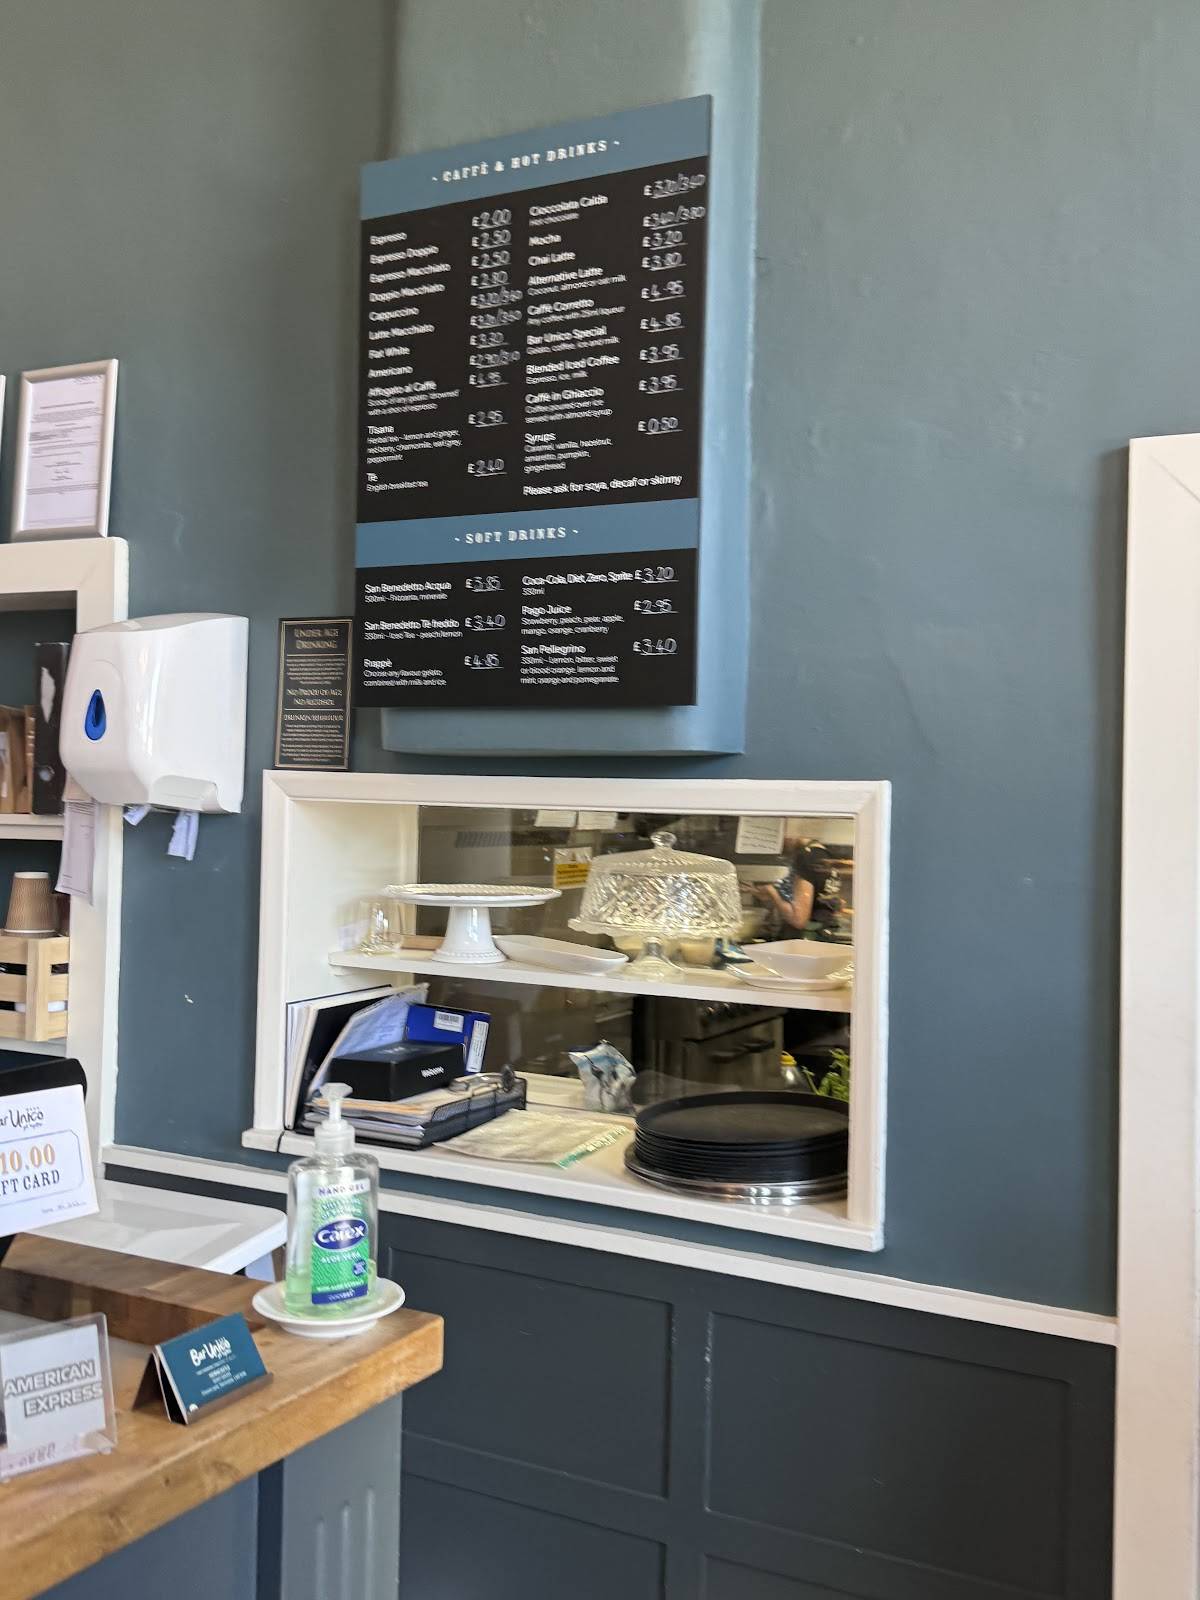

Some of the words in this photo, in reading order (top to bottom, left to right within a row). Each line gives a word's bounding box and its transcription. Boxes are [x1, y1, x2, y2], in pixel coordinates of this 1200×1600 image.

[443, 161, 488, 182] CAFFÈ
[494, 161, 504, 172] &
[511, 153, 540, 169] HOT
[546, 140, 607, 162] DRINKS
[529, 201, 579, 216] Cioccolata
[579, 194, 608, 207] Calda
[370, 232, 407, 245] Espresso
[529, 234, 561, 246] Mocha
[528, 254, 550, 266] Chai
[550, 252, 576, 263] Latte
[528, 271, 578, 286] Alternative
[577, 267, 603, 278] Latte
[369, 307, 419, 321] Cappuccino
[369, 330, 390, 340] Latte
[389, 324, 435, 337] Macchiato
[527, 335, 543, 345] Bar
[543, 332, 572, 343] Unico
[571, 325, 607, 340] Special
[368, 350, 385, 359] Flat
[384, 346, 410, 357] White
[368, 366, 413, 378] Americano
[526, 361, 565, 374] Blended
[565, 358, 586, 370] Iced
[586, 355, 620, 367] Coffee
[551, 392, 562, 401] in
[465, 532, 502, 544] SOFT
[508, 527, 566, 541] DRINKS
[0, 1115, 8, 1127] ar
[23, 1169, 60, 1191] CARD
[317, 1225, 365, 1243] Carex
[4, 1360, 97, 1398] AMERICAN
[24, 1383, 104, 1418] EXPRESS
